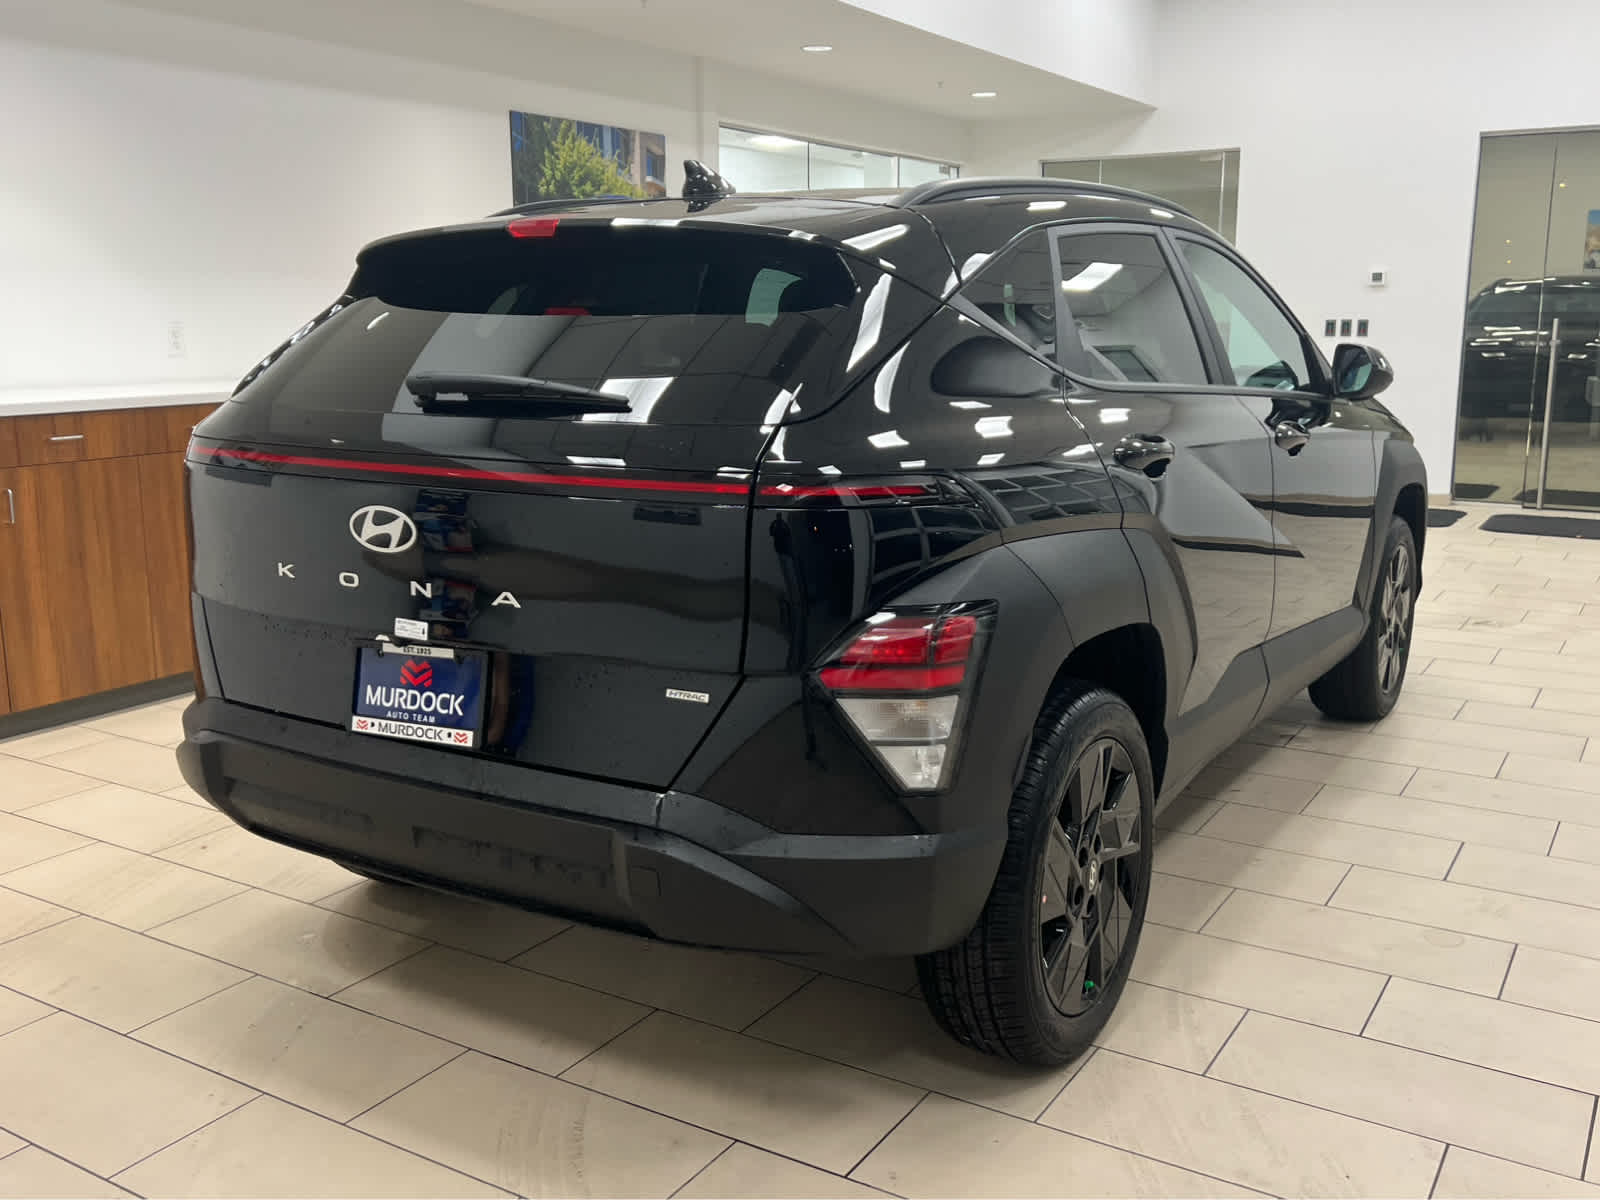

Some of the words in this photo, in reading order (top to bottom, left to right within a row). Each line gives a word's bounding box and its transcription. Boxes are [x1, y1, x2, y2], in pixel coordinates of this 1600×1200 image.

[277, 562, 522, 609] KONA
[365, 684, 465, 716] MURDOCK
[668, 690, 706, 701] HTRAC
[386, 711, 409, 720] AUTO
[412, 713, 436, 723] TEAM
[377, 722, 444, 741] MURDOCK
